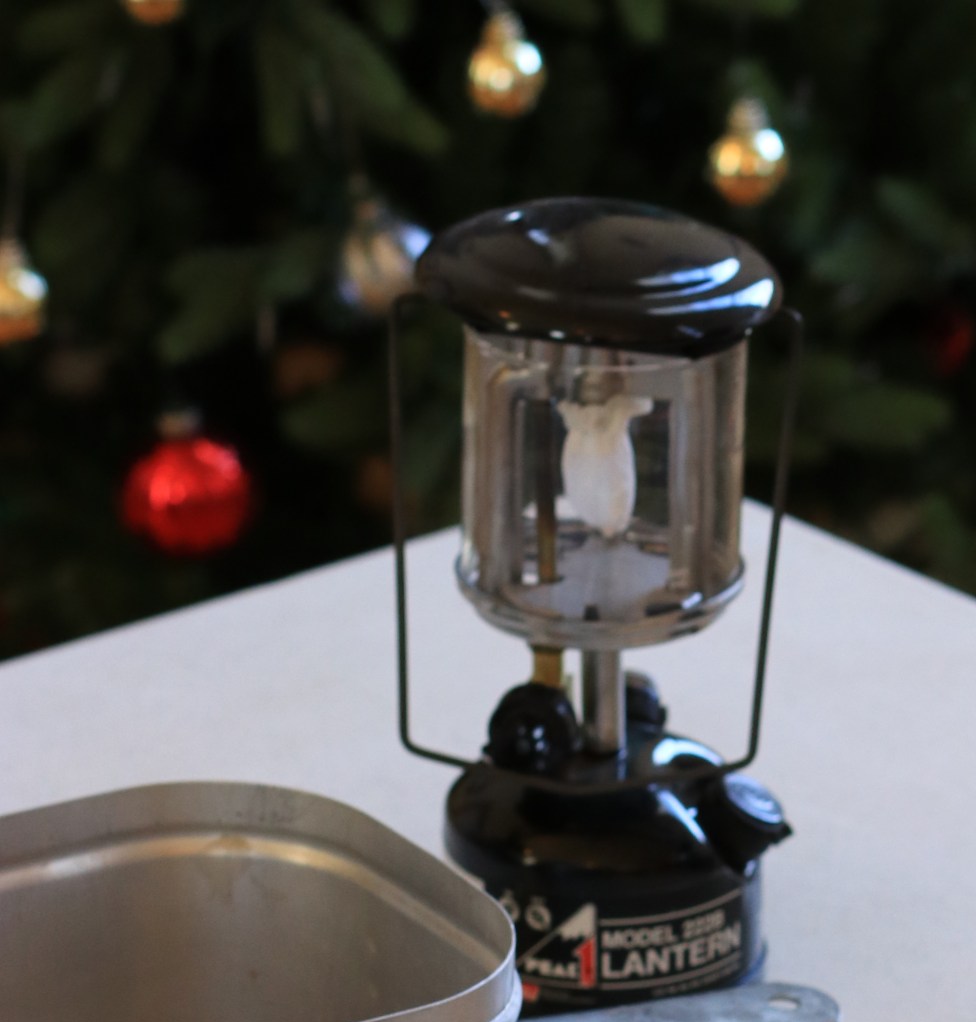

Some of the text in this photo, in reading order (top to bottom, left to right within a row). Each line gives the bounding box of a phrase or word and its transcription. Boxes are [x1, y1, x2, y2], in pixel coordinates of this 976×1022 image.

[573, 936, 597, 988] 1
[601, 924, 678, 949] MODEL
[601, 920, 742, 980] LANTERN
